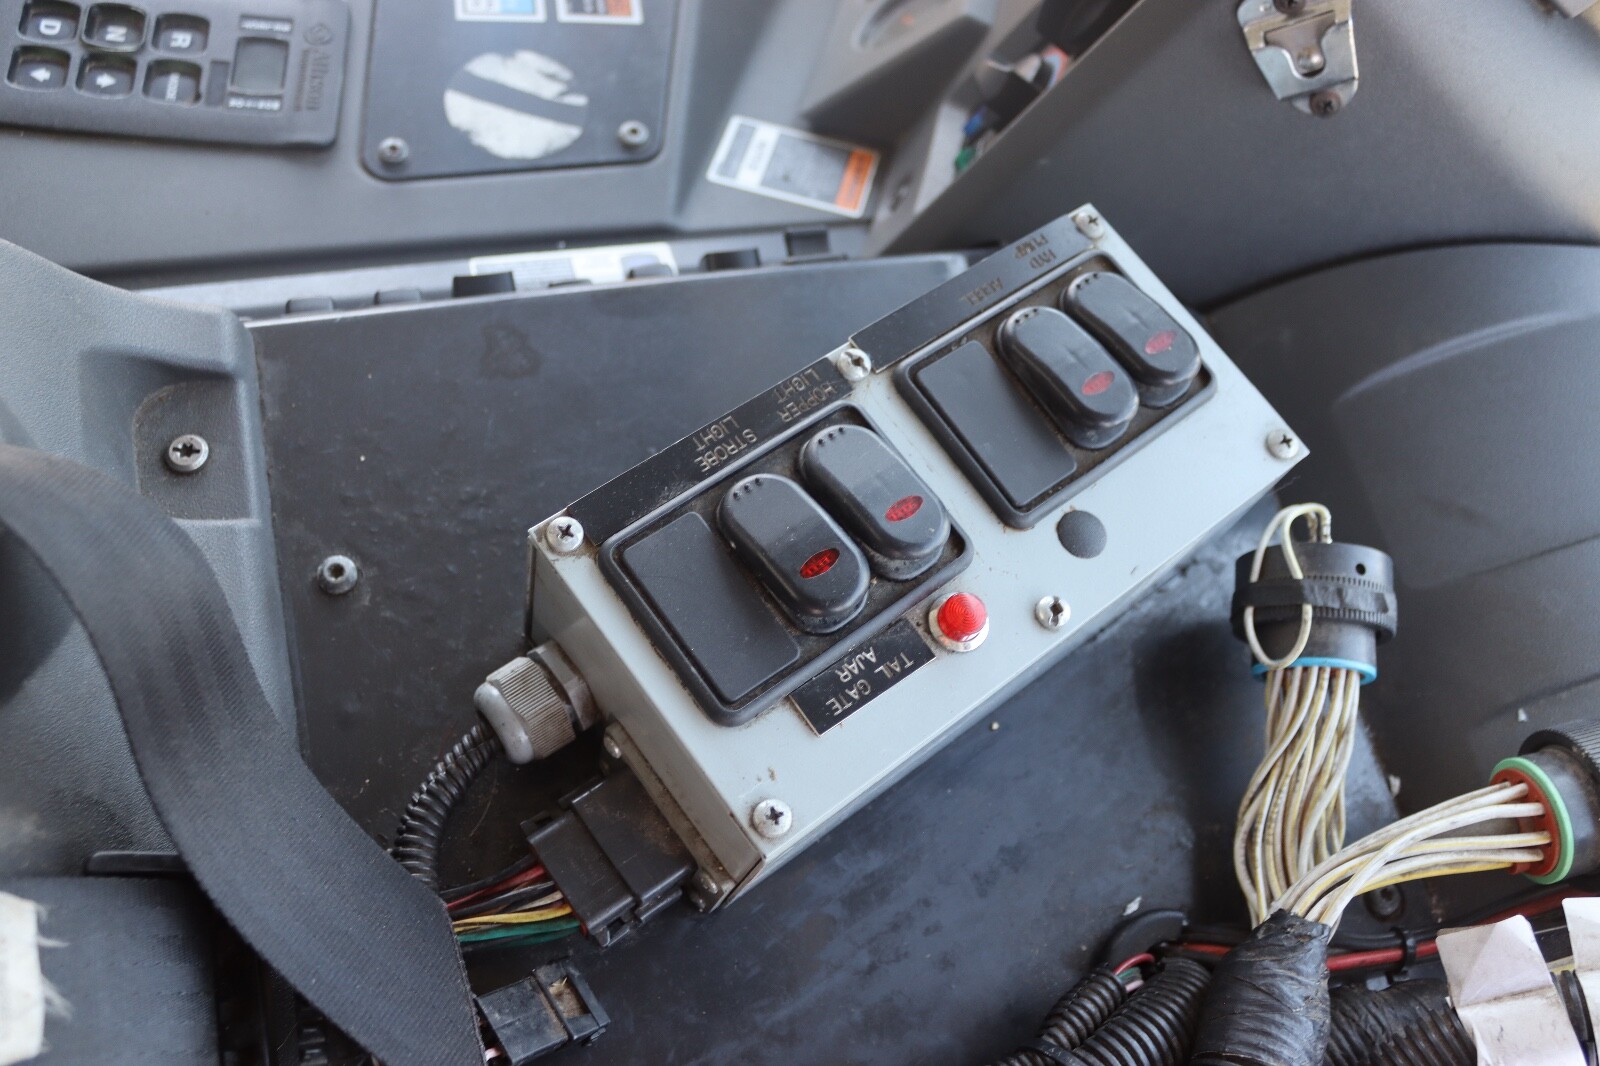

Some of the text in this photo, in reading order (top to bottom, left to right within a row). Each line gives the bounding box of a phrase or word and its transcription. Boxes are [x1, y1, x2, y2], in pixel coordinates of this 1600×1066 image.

[39, 19, 62, 36] D
[105, 25, 128, 42] N
[170, 31, 193, 48] R
[773, 367, 821, 404] LIGHT
[776, 381, 838, 423] HOPPER
[692, 415, 740, 452] LIGHT
[694, 428, 758, 473] STROBE
[835, 646, 877, 683] AJAR
[825, 679, 872, 716] GATE
